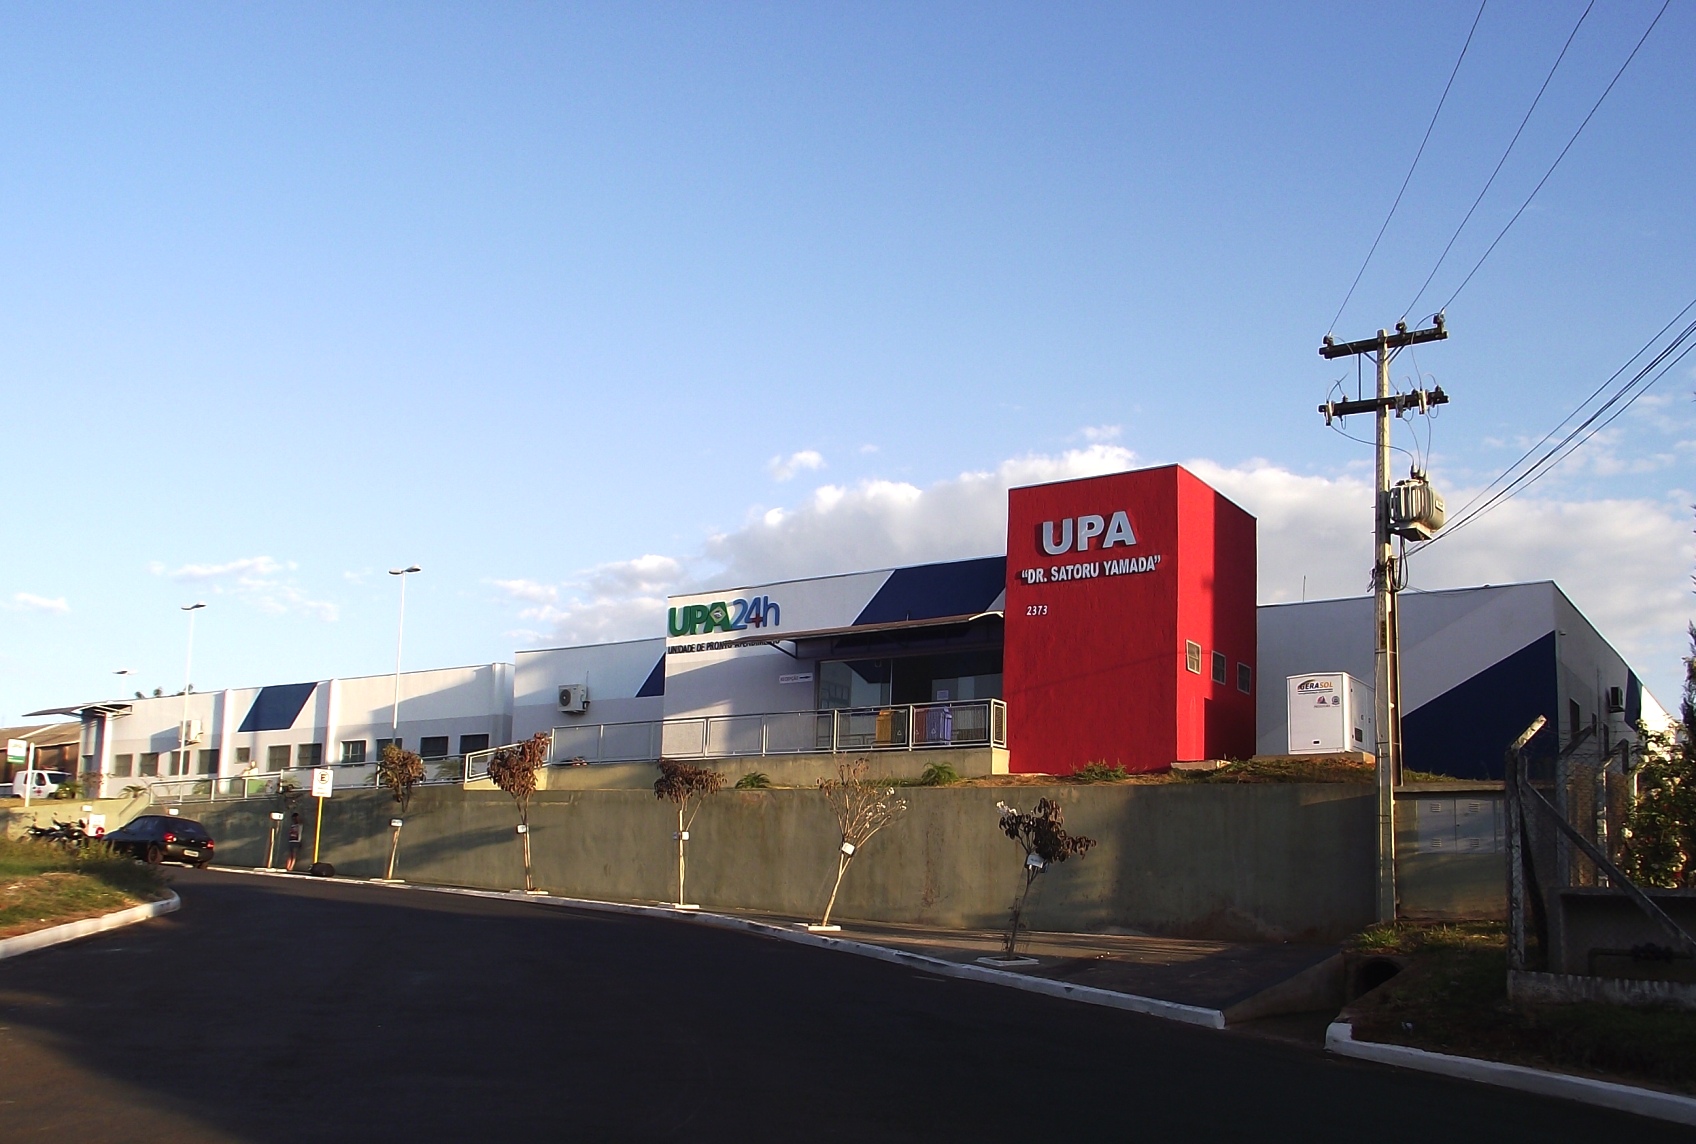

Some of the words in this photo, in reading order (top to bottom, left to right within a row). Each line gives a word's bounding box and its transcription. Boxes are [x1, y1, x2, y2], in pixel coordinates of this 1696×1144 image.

[1042, 511, 1136, 555] UPA
[1051, 562, 1099, 582] SATORU
[1026, 605, 1048, 616] 2373
[667, 643, 696, 654] UNIDADE
[696, 642, 705, 652] DE
